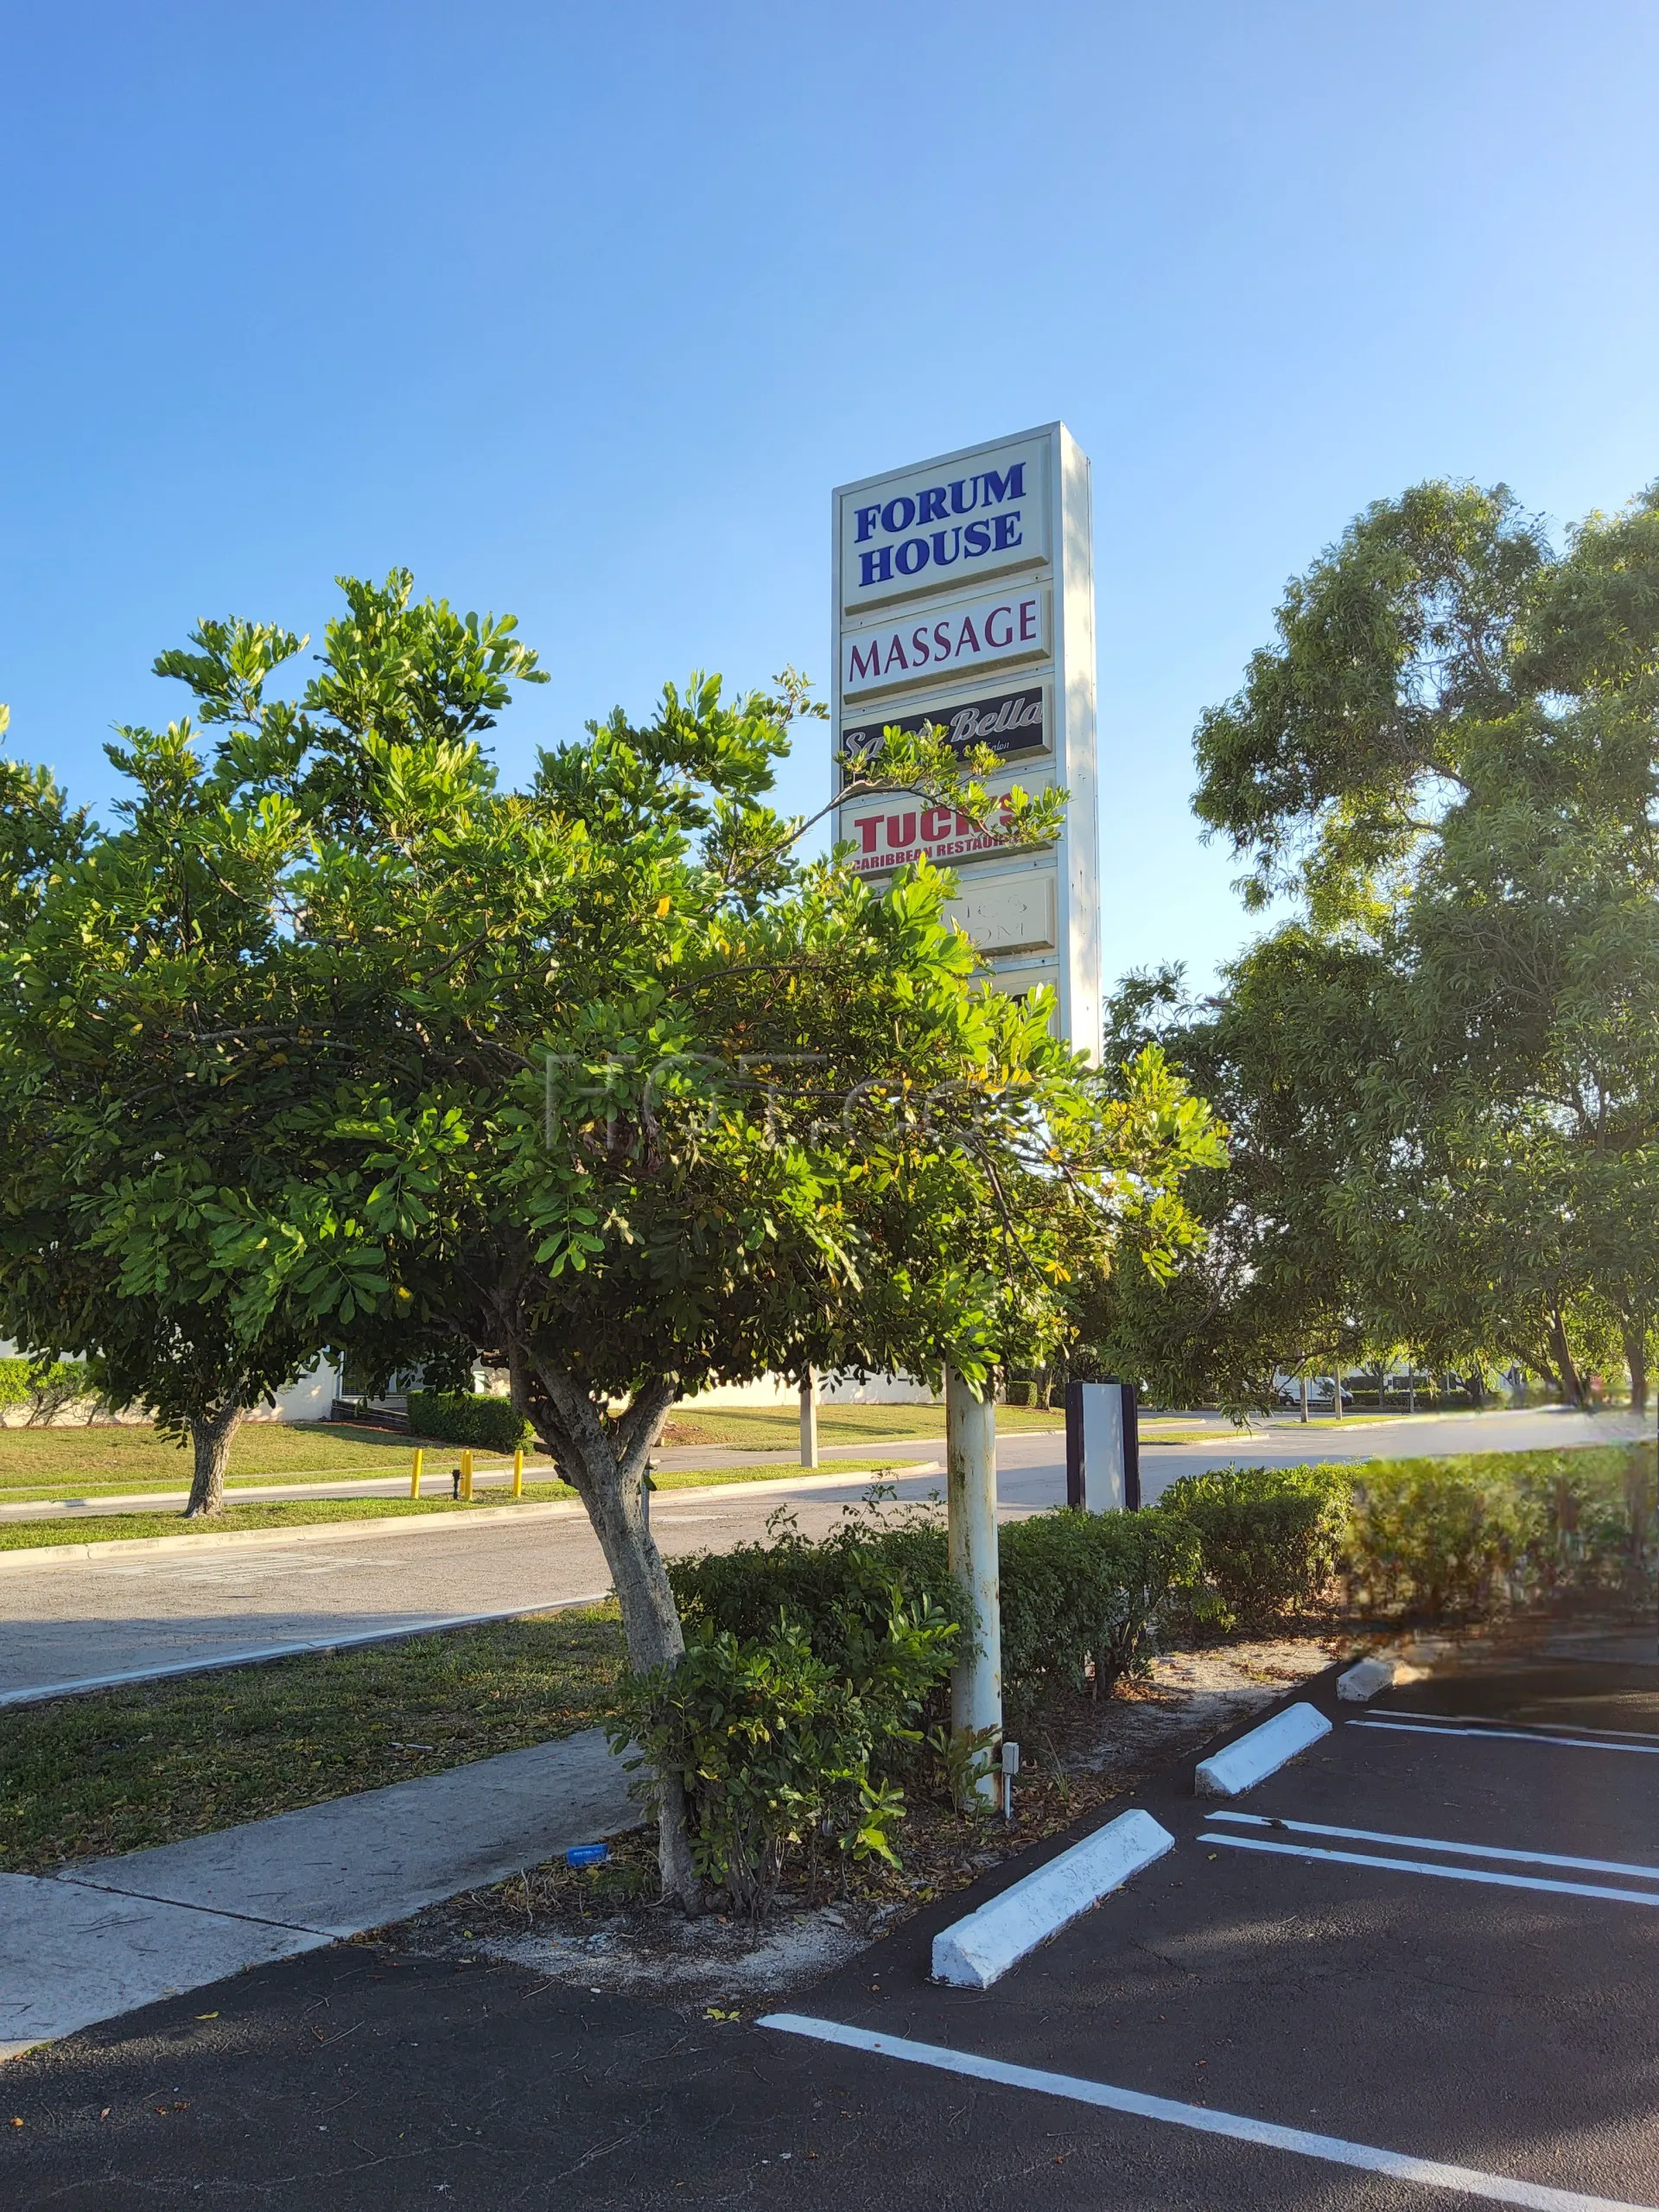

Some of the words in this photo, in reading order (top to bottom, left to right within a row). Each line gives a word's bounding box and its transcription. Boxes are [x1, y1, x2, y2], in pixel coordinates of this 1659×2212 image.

[854, 461, 1027, 543] FORUM
[858, 511, 1023, 587] HOUSE
[849, 600, 1036, 683] MASSAGE
[950, 696, 1042, 742] Bella
[853, 846, 932, 871] CARIBBEAN
[936, 833, 1018, 856] RESTAU
